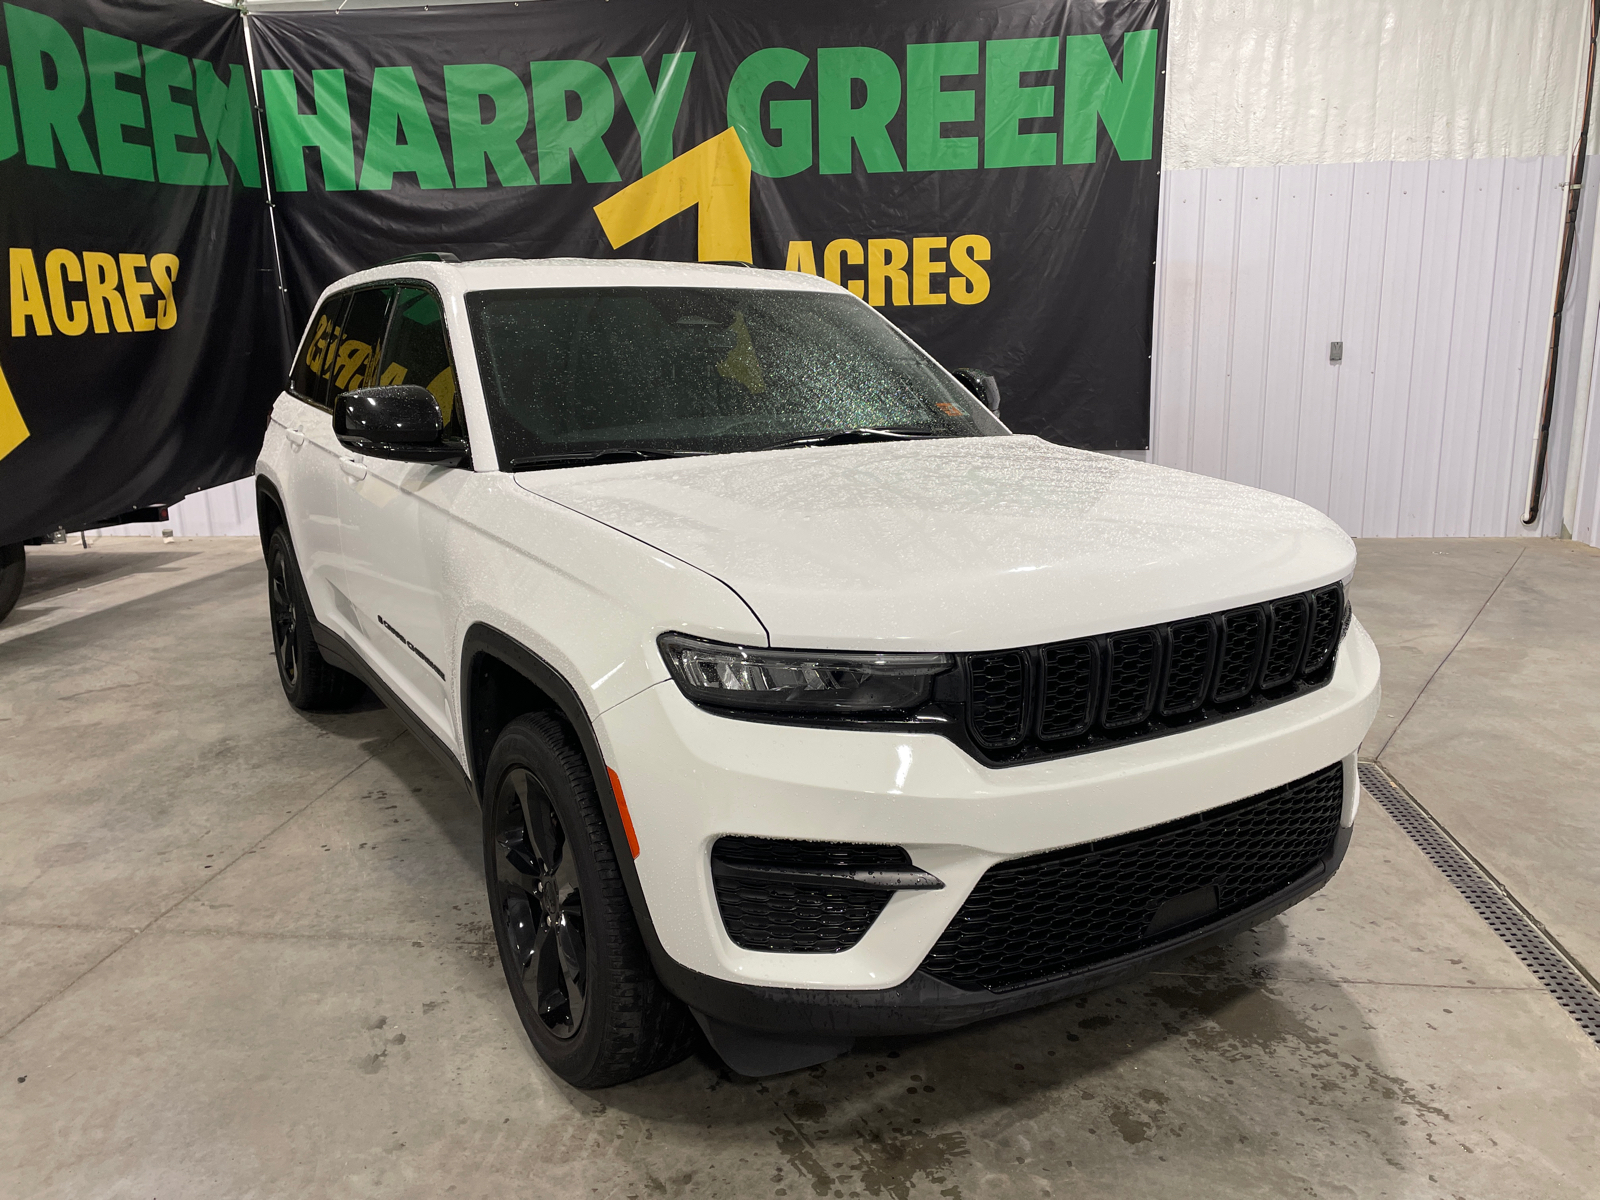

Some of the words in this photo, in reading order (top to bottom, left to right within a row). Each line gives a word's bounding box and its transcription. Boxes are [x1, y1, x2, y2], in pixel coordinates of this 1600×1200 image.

[0, 2, 261, 188] REEN
[261, 51, 697, 192] HARRY
[726, 29, 1159, 178] GREEN
[9, 247, 180, 337] ACRES
[784, 234, 991, 307] ACRES
